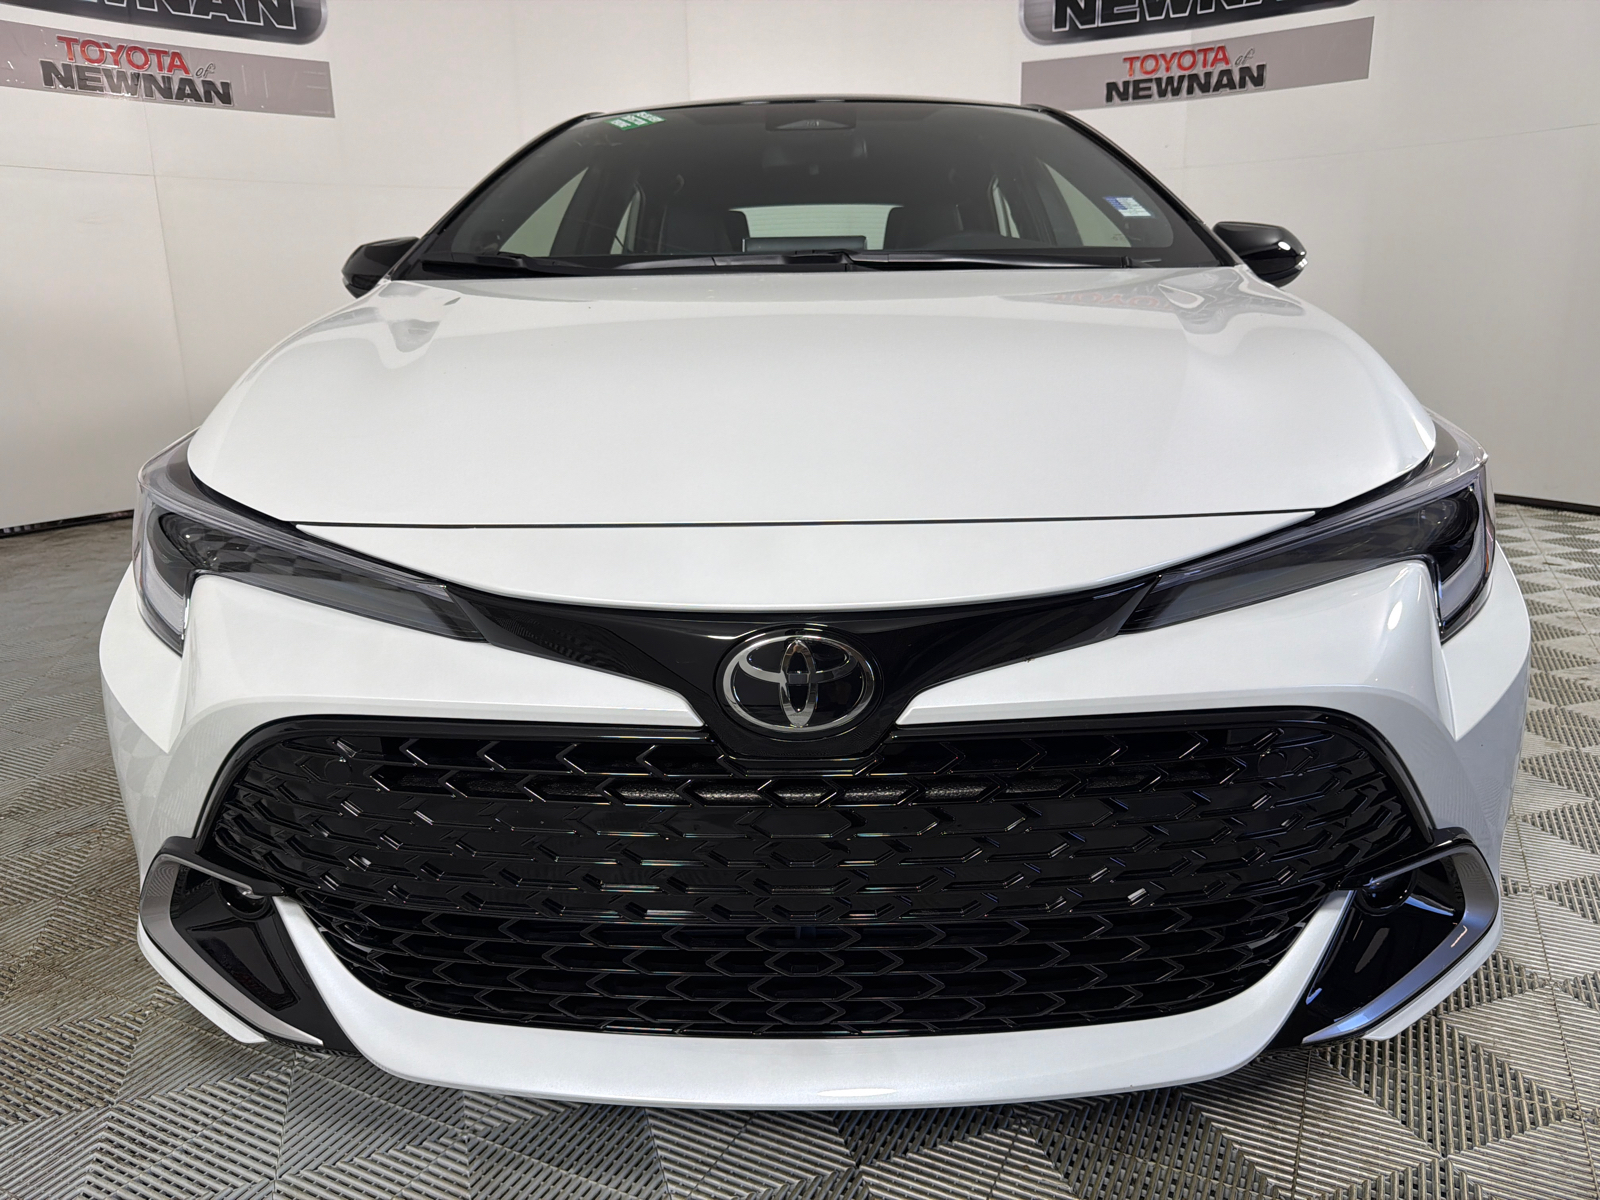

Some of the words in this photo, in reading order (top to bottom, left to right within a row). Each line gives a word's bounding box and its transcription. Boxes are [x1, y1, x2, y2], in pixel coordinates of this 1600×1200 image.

[57, 35, 191, 76] TOYOTA
[195, 62, 216, 79] of
[1123, 45, 1231, 77] TOYOTA
[1234, 48, 1255, 66] of
[39, 59, 233, 105] NEWNAN
[1105, 64, 1267, 103] NEWNAN
